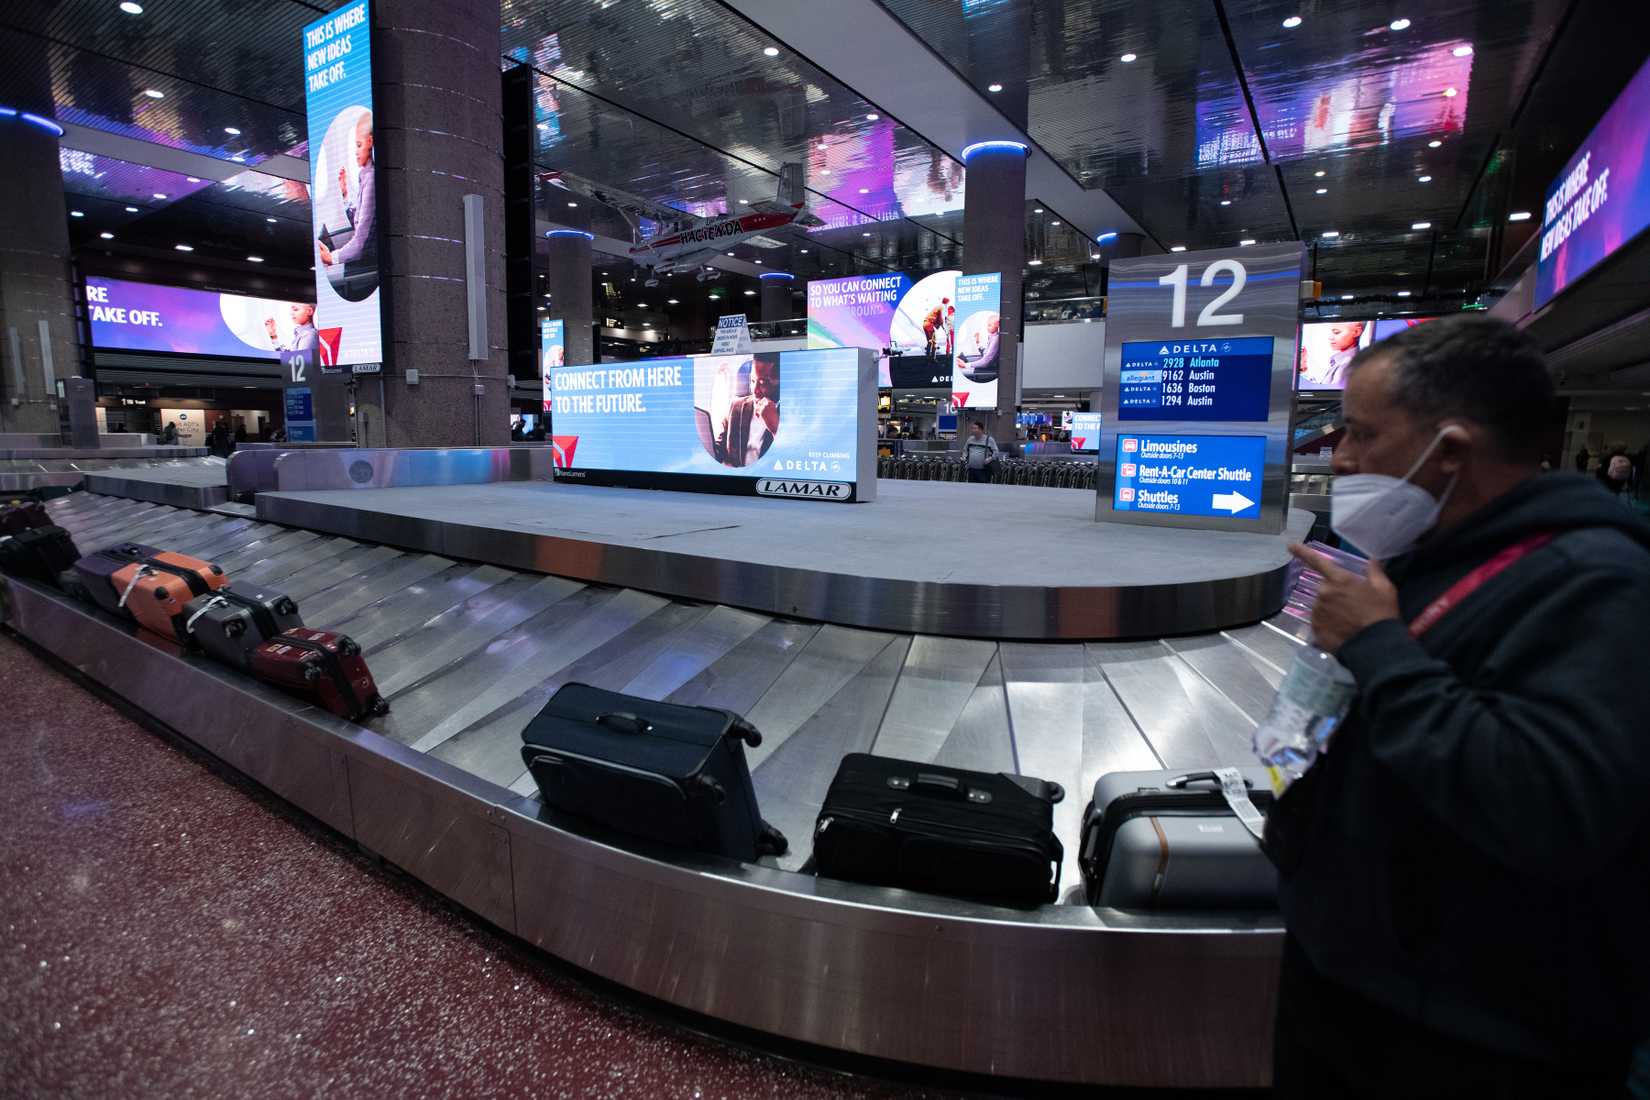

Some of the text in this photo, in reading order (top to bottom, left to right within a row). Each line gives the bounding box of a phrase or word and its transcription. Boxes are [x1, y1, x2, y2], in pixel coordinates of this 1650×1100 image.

[306, 3, 365, 49] THIS IS WHERE
[307, 34, 351, 71] NEW IDEAS
[308, 61, 347, 93] TAKE OFF.
[1572, 186, 1592, 232] TAKE
[680, 221, 744, 244] HACIENDA
[810, 276, 902, 296] SO YOU CAN CONNECT
[1159, 259, 1246, 328] 12
[810, 290, 897, 308] TO WHAT'S WAITING
[129, 309, 163, 327] OFF.
[719, 317, 744, 328] NOTICE
[1173, 344, 1217, 354] DELTA
[288, 354, 306, 382] 12
[1163, 357, 1184, 368] 2928
[1190, 357, 1219, 368] Atlanta
[555, 366, 682, 391] CONNECT FROM HERE
[1162, 370, 1184, 381] 9162
[1188, 370, 1215, 380] Austin
[1162, 382, 1183, 393] 1636
[1188, 382, 1216, 393] Boston
[556, 394, 647, 414] TO THE FUTURE.
[1161, 395, 1182, 406] 1294
[1187, 396, 1213, 406] Austin
[1141, 440, 1198, 454] Limousines
[786, 460, 828, 472] DELTA
[1140, 464, 1252, 482] Rent-A-Car Center Shuttle
[764, 481, 840, 497] LAMAR
[1138, 488, 1179, 504] Shuttles
